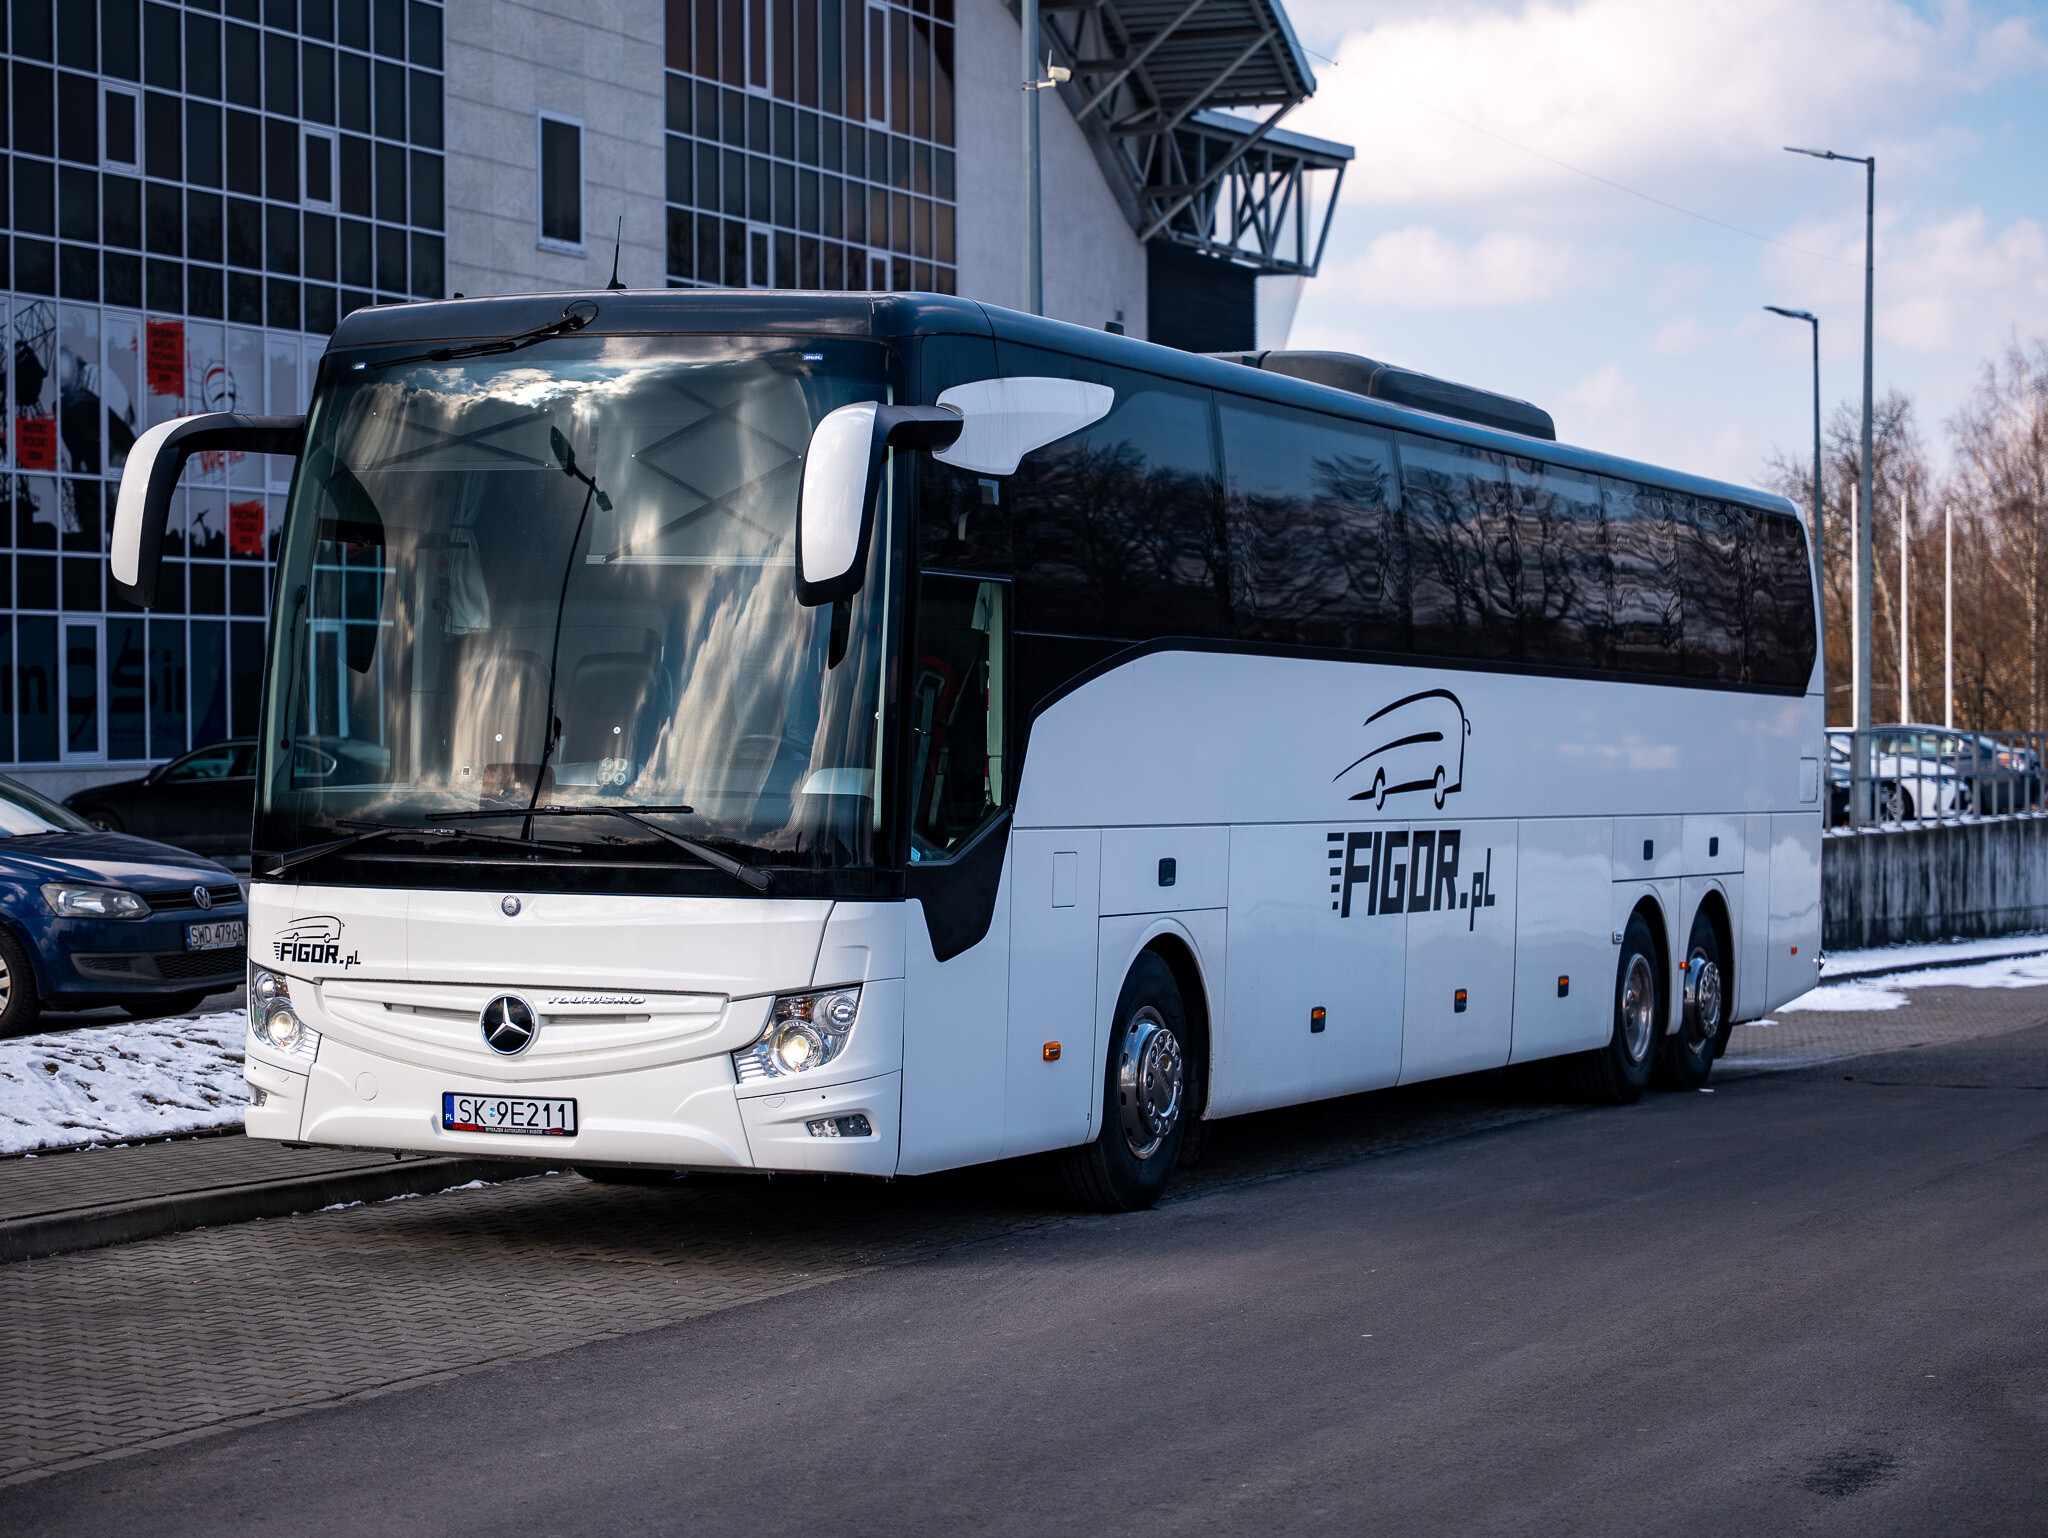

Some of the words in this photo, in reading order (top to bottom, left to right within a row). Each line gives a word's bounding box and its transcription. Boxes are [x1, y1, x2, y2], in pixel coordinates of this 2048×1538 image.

[23, 435, 48, 448] POLSKI
[191, 925, 212, 944] SWD
[214, 922, 245, 942] 4796A
[548, 995, 646, 1005] TOURISMO
[445, 1113, 454, 1121] PL
[459, 1099, 487, 1124] SK
[496, 1101, 566, 1128] 9E211
